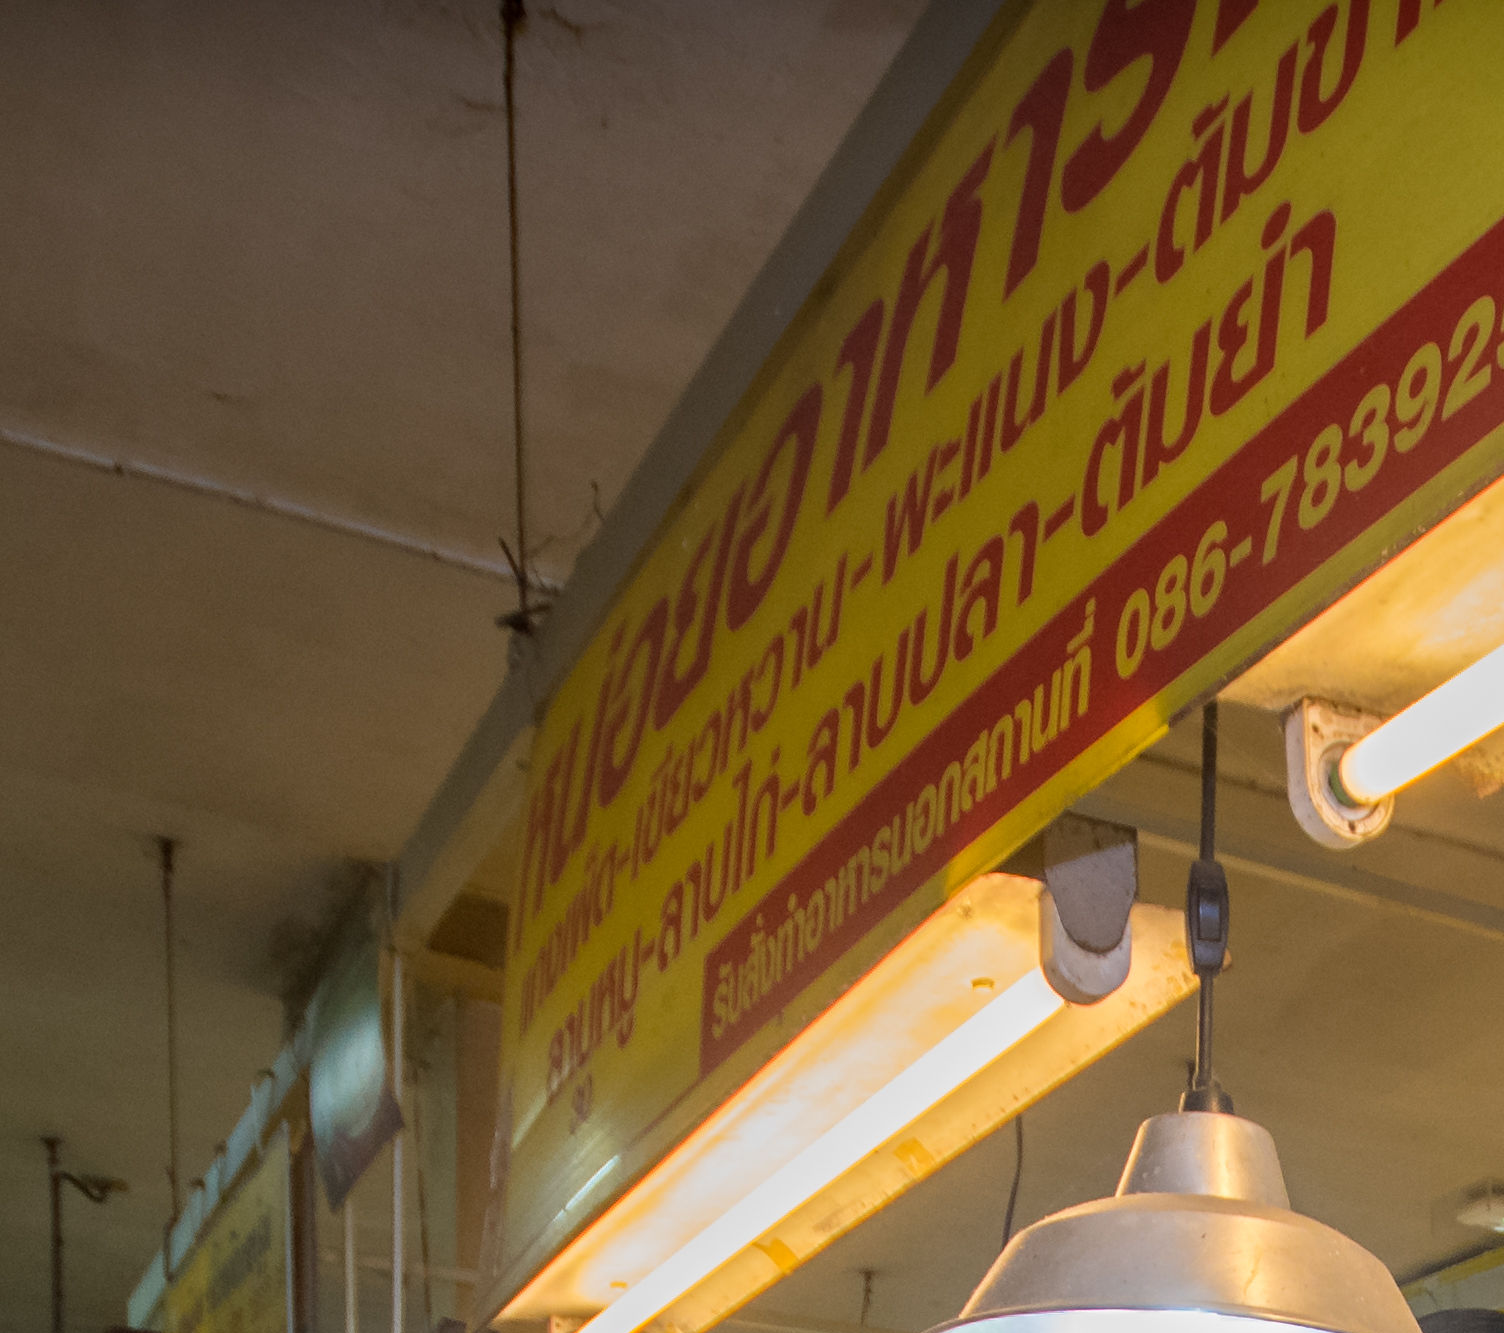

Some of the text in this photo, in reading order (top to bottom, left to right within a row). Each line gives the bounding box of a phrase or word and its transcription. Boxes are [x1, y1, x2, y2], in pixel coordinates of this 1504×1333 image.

[515, 0, 1261, 955] หน่อยอาหาร
[710, 597, 1095, 1040] รับสั่งทำอาหารนอกสถานที่
